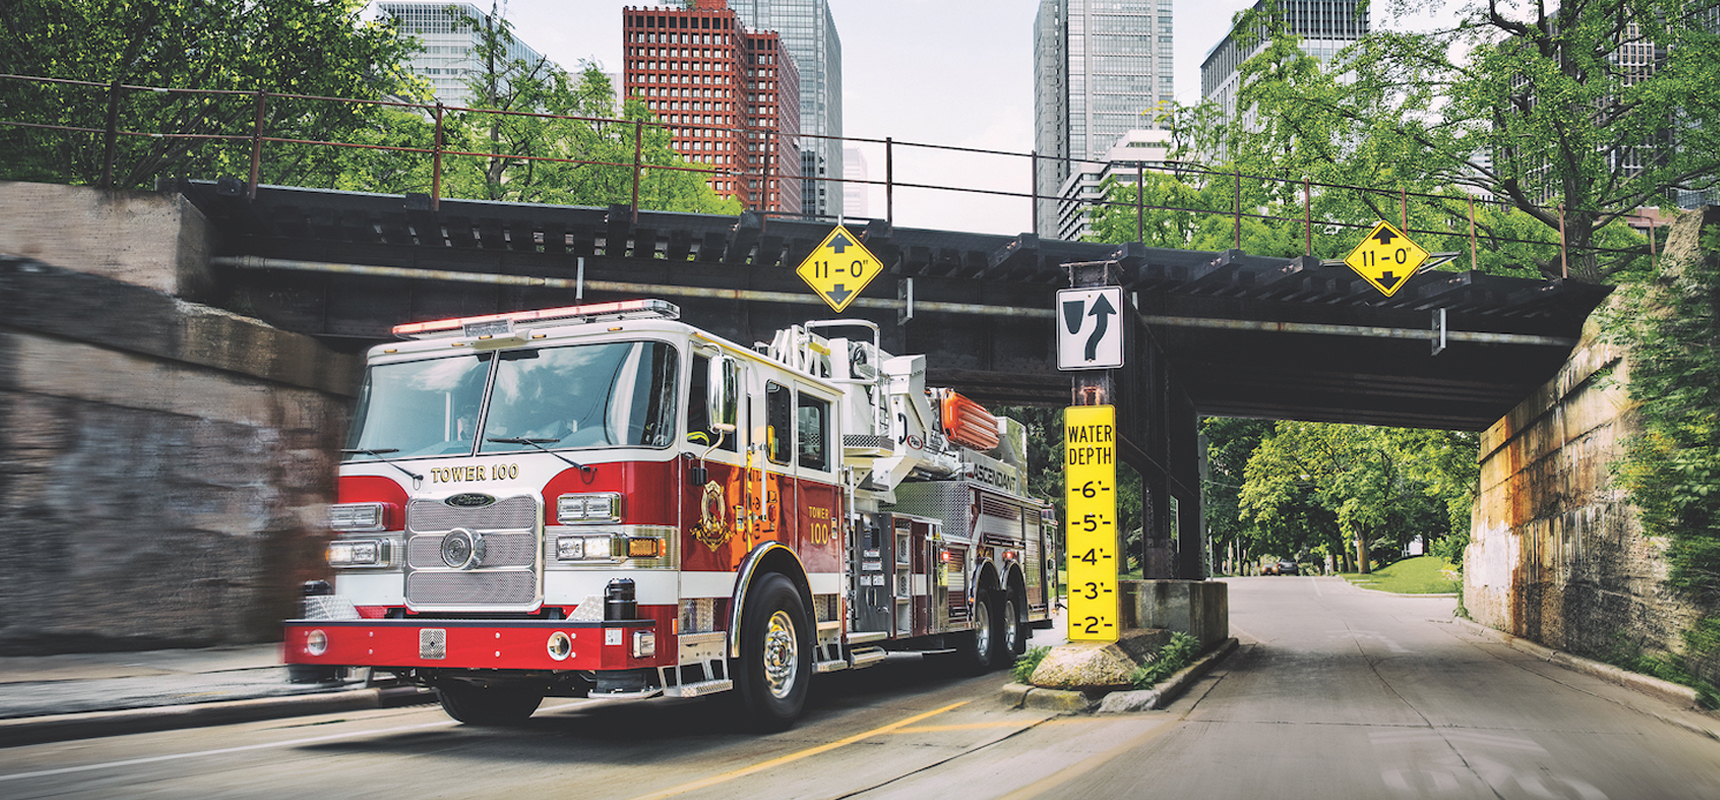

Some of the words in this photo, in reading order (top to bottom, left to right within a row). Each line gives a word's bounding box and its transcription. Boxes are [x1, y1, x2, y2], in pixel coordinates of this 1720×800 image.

[1068, 424, 1112, 443] WATER
[1069, 447, 1112, 466] DEPTH
[430, 465, 487, 484] TOWER
[492, 463, 520, 481] 100
[808, 505, 830, 520] TOWER
[810, 522, 829, 546] 100
